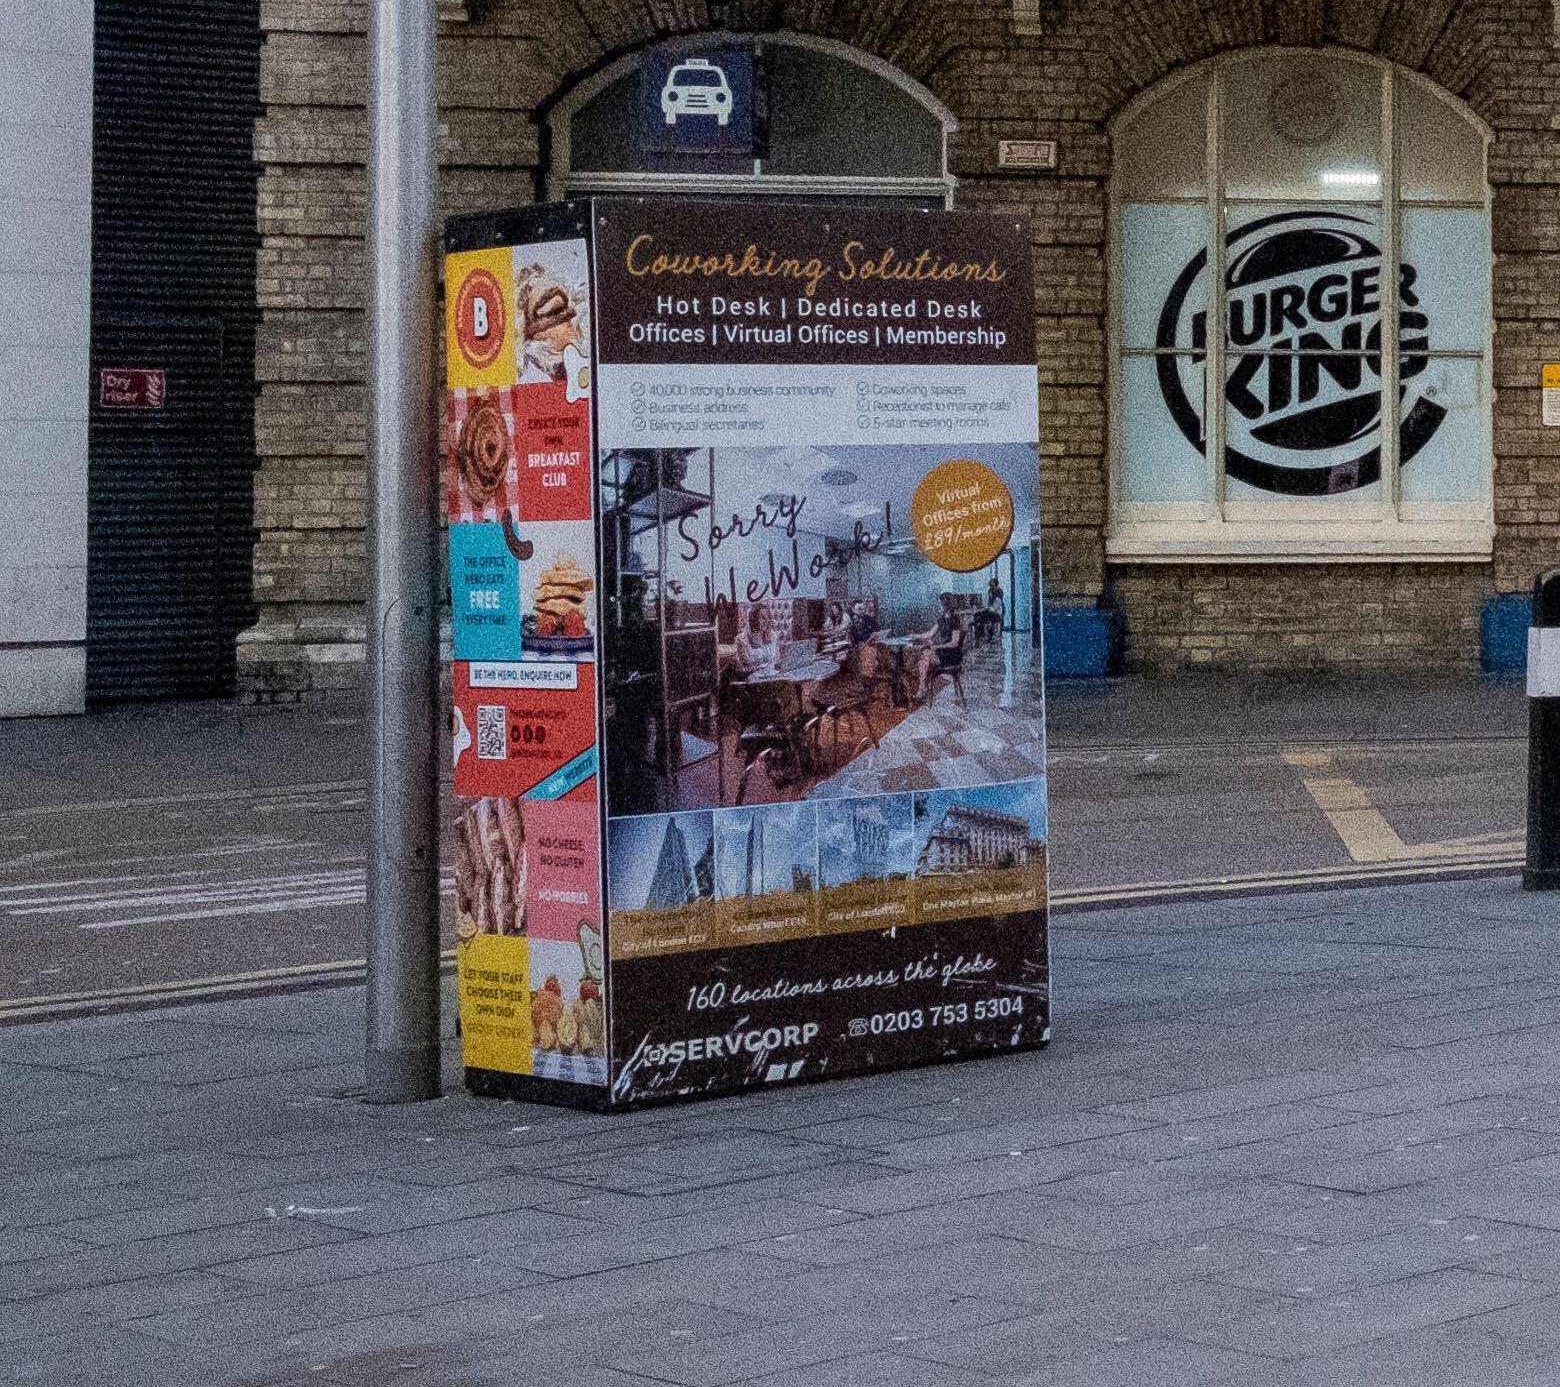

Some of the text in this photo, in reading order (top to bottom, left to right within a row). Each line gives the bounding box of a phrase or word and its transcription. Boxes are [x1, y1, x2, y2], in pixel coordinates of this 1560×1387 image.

[625, 233, 1008, 296] Coworking Solutions
[473, 297, 489, 338] B
[657, 295, 982, 321] Hot Desk Dedicated Desk
[629, 322, 1008, 349] Offices Virtual Offices Membership
[106, 374, 131, 391] Dry
[1200, 311, 1430, 444] KING
[105, 391, 139, 403] riser
[528, 452, 581, 468] BREAKFAST
[542, 472, 568, 488] CLUB
[936, 481, 981, 505] Virtual
[922, 497, 1003, 527] Offices from
[677, 494, 807, 562] Sorry
[704, 499, 894, 629] WeWork!
[469, 591, 501, 610] FREE
[685, 953, 999, 1013] 160 locations across the globe
[869, 995, 1025, 1036] 0203 753 5304
[668, 1022, 820, 1066] SERVCORP
